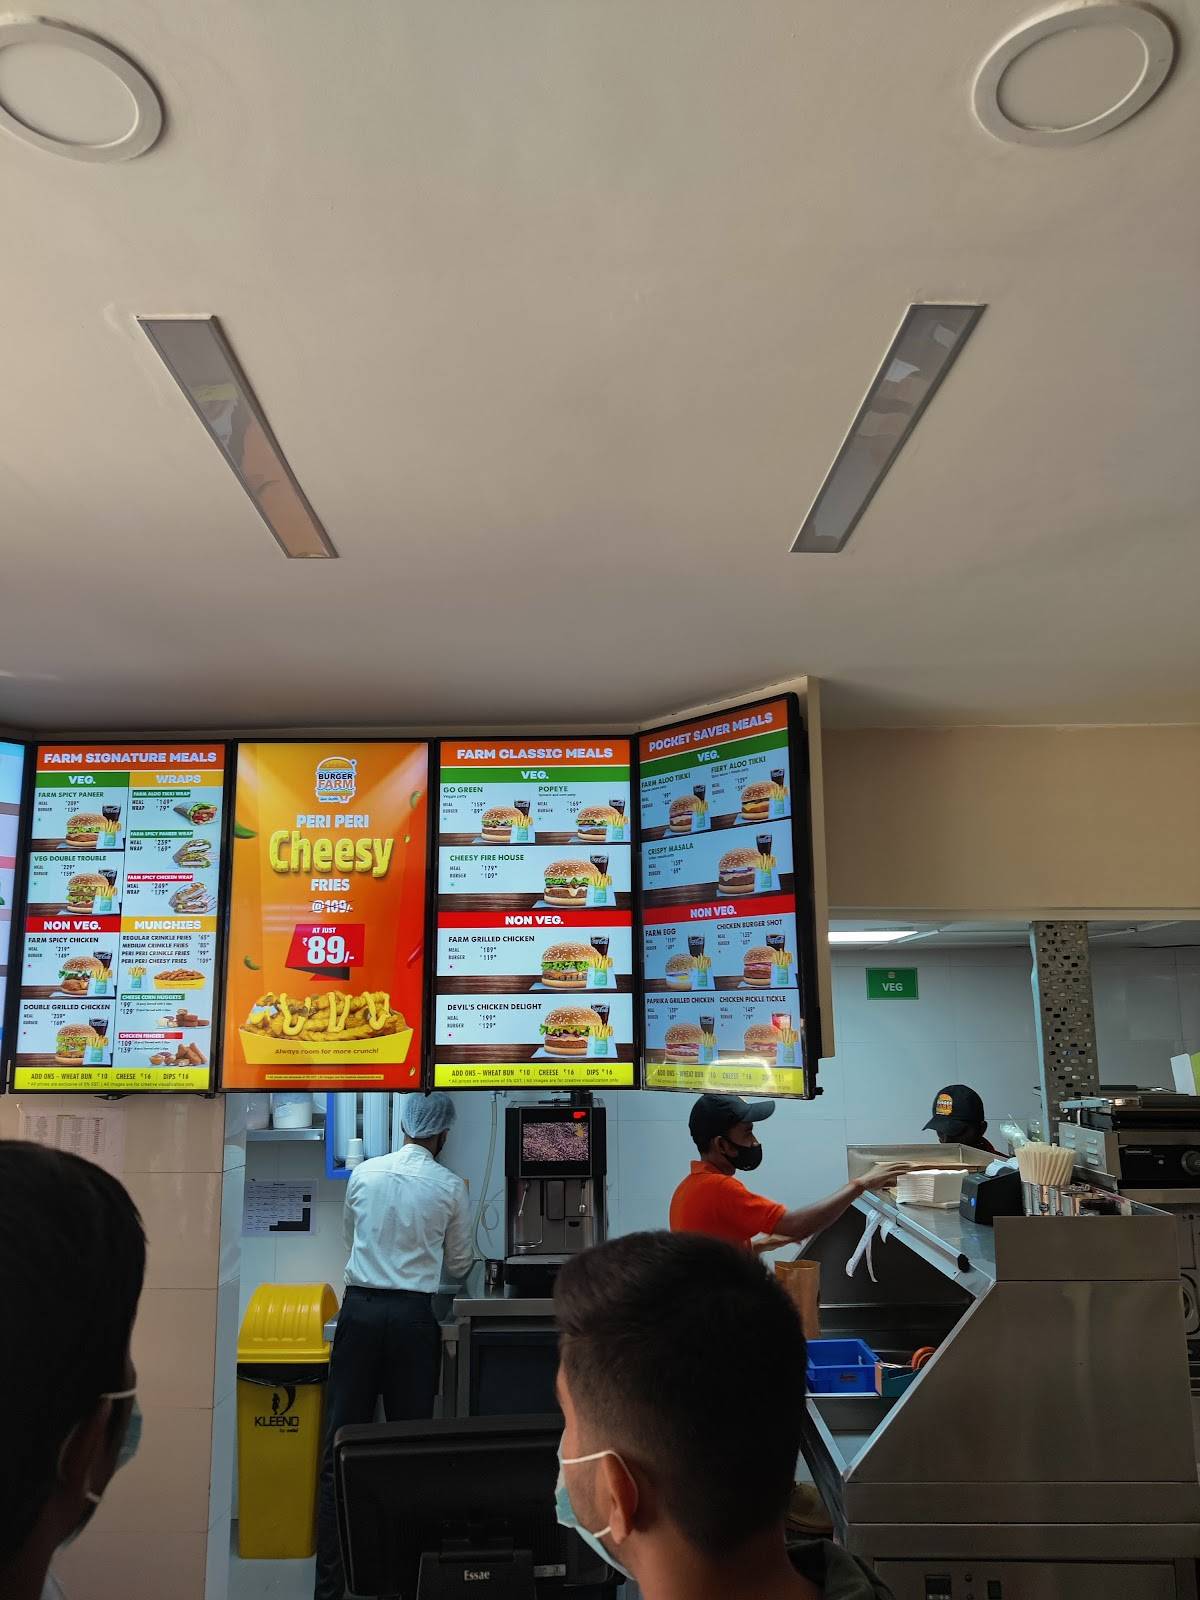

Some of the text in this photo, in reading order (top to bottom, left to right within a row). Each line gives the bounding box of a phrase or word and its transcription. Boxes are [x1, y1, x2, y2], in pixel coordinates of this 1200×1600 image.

[649, 712, 773, 752] POCKET SAVER MEALS
[44, 752, 216, 763] FARM SIGNATURE MEALS
[457, 748, 613, 759] FARM CLASSIC MEALS
[697, 750, 719, 762] VEG.
[729, 760, 747, 769] ALOO
[68, 776, 96, 784] VEG.
[156, 774, 201, 783] WRAPS
[521, 770, 549, 779] VEG.
[319, 780, 352, 788] FARM
[641, 780, 657, 788] FARM
[658, 775, 674, 784] ALOO
[296, 815, 369, 828] PERI PERI
[269, 830, 394, 877] Cheesy
[648, 843, 694, 855] CRISPY MASALA
[311, 878, 350, 891] FRIES
[690, 905, 737, 918] NON VEG.
[44, 921, 101, 930] NON VEG.
[134, 921, 201, 930] MUNCHIES
[505, 916, 564, 925] NON VEG.
[717, 922, 741, 930] CHICKEN
[302, 935, 354, 964] ₹89/-
[881, 982, 903, 992] VEG
